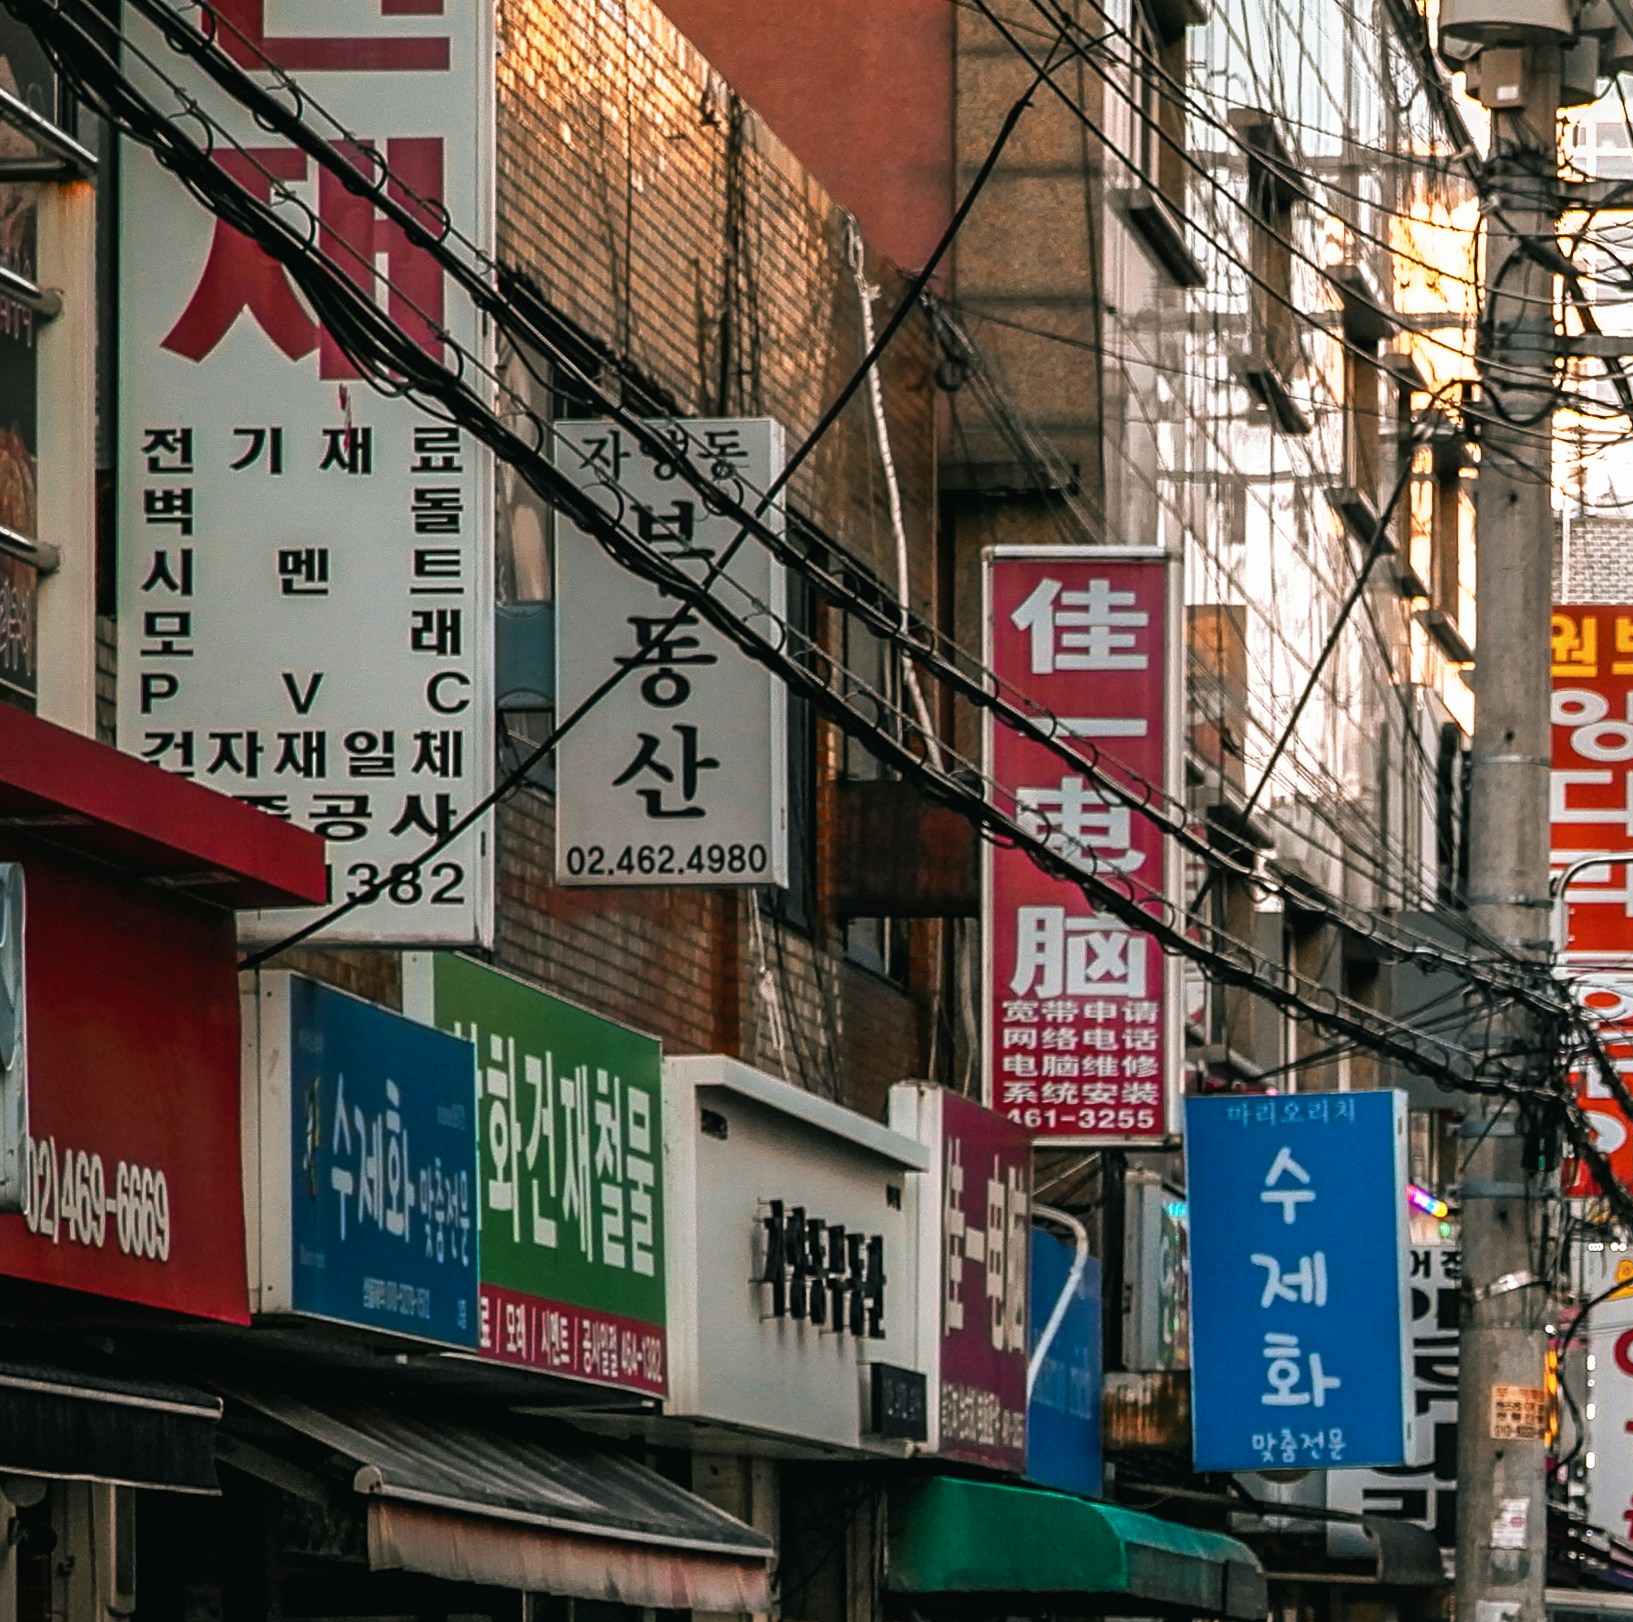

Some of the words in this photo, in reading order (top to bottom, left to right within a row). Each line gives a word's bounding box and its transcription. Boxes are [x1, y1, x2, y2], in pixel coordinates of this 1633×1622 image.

[160, 0, 450, 381] 재
[141, 426, 466, 476] 전기재료
[143, 487, 466, 536] 벽돌
[142, 546, 467, 596] 시멘트
[140, 609, 463, 657] 모래
[612, 500, 720, 819] 부동산
[140, 671, 472, 716] PVC
[143, 730, 464, 780] 건자재일체
[1009, 577, 1150, 999] 佳一电脑
[566, 843, 768, 876] 02.462.4980
[1002, 1000, 1158, 1024] 宽带申请
[1002, 1027, 1158, 1051] 网络电话
[1002, 1054, 1158, 1079] 电脑维修
[1002, 1081, 1158, 1106] 系统安装
[1006, 1107, 1156, 1131] 461-3255
[331, 1072, 416, 1244] 수제화
[420, 1156, 470, 1267] 맞춤전문
[1250, 1146, 1344, 1409] 수제화
[1251, 1427, 1348, 1463] 맞춤전문
